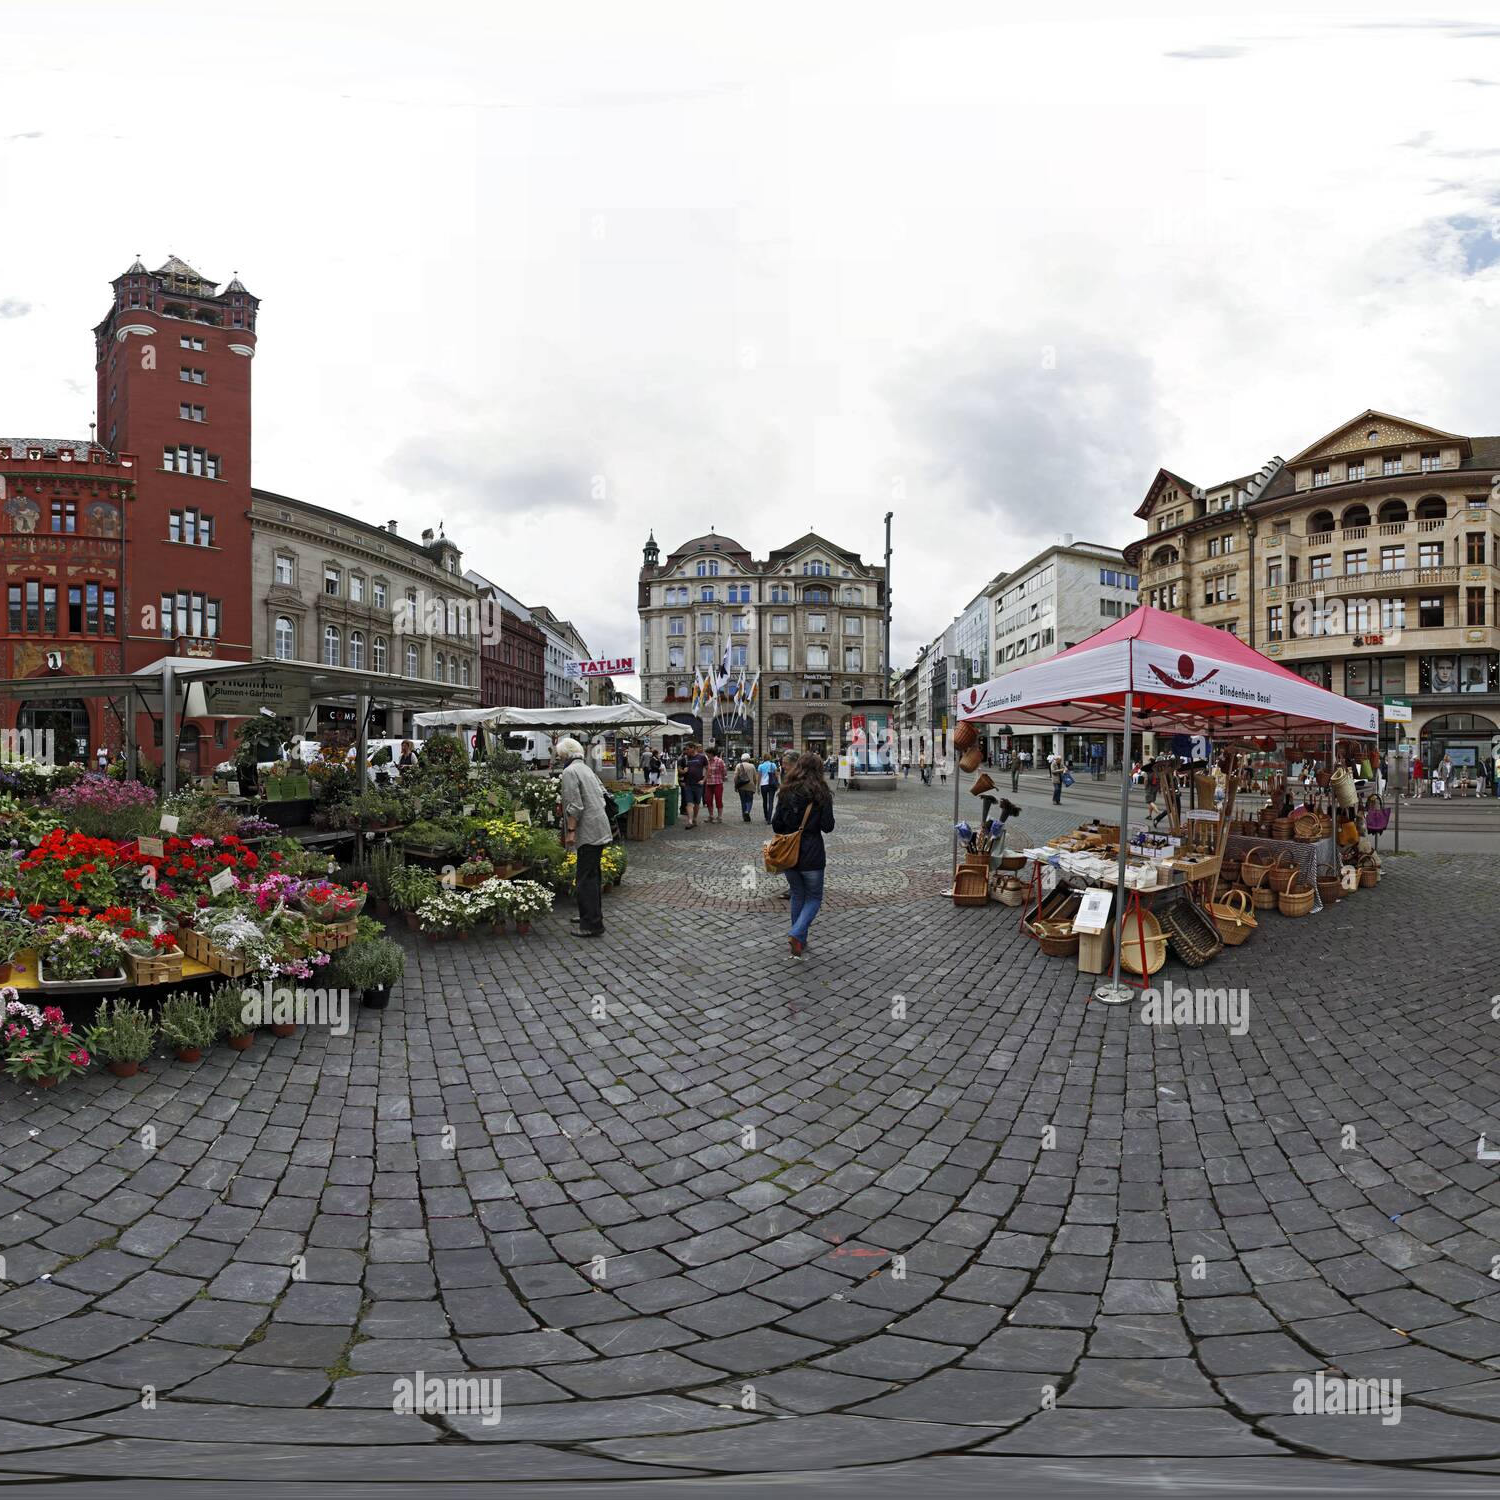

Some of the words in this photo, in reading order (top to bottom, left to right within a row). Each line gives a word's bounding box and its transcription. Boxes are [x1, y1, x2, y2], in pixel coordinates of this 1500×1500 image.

[1364, 635, 1384, 646] UBS
[579, 657, 632, 672] TATLIN
[987, 695, 1009, 709] Blindenheim
[1010, 691, 1022, 703] Basel
[1220, 684, 1256, 700] Blindenheim
[1257, 691, 1271, 704] Basel
[329, 711, 376, 722] COMPS
